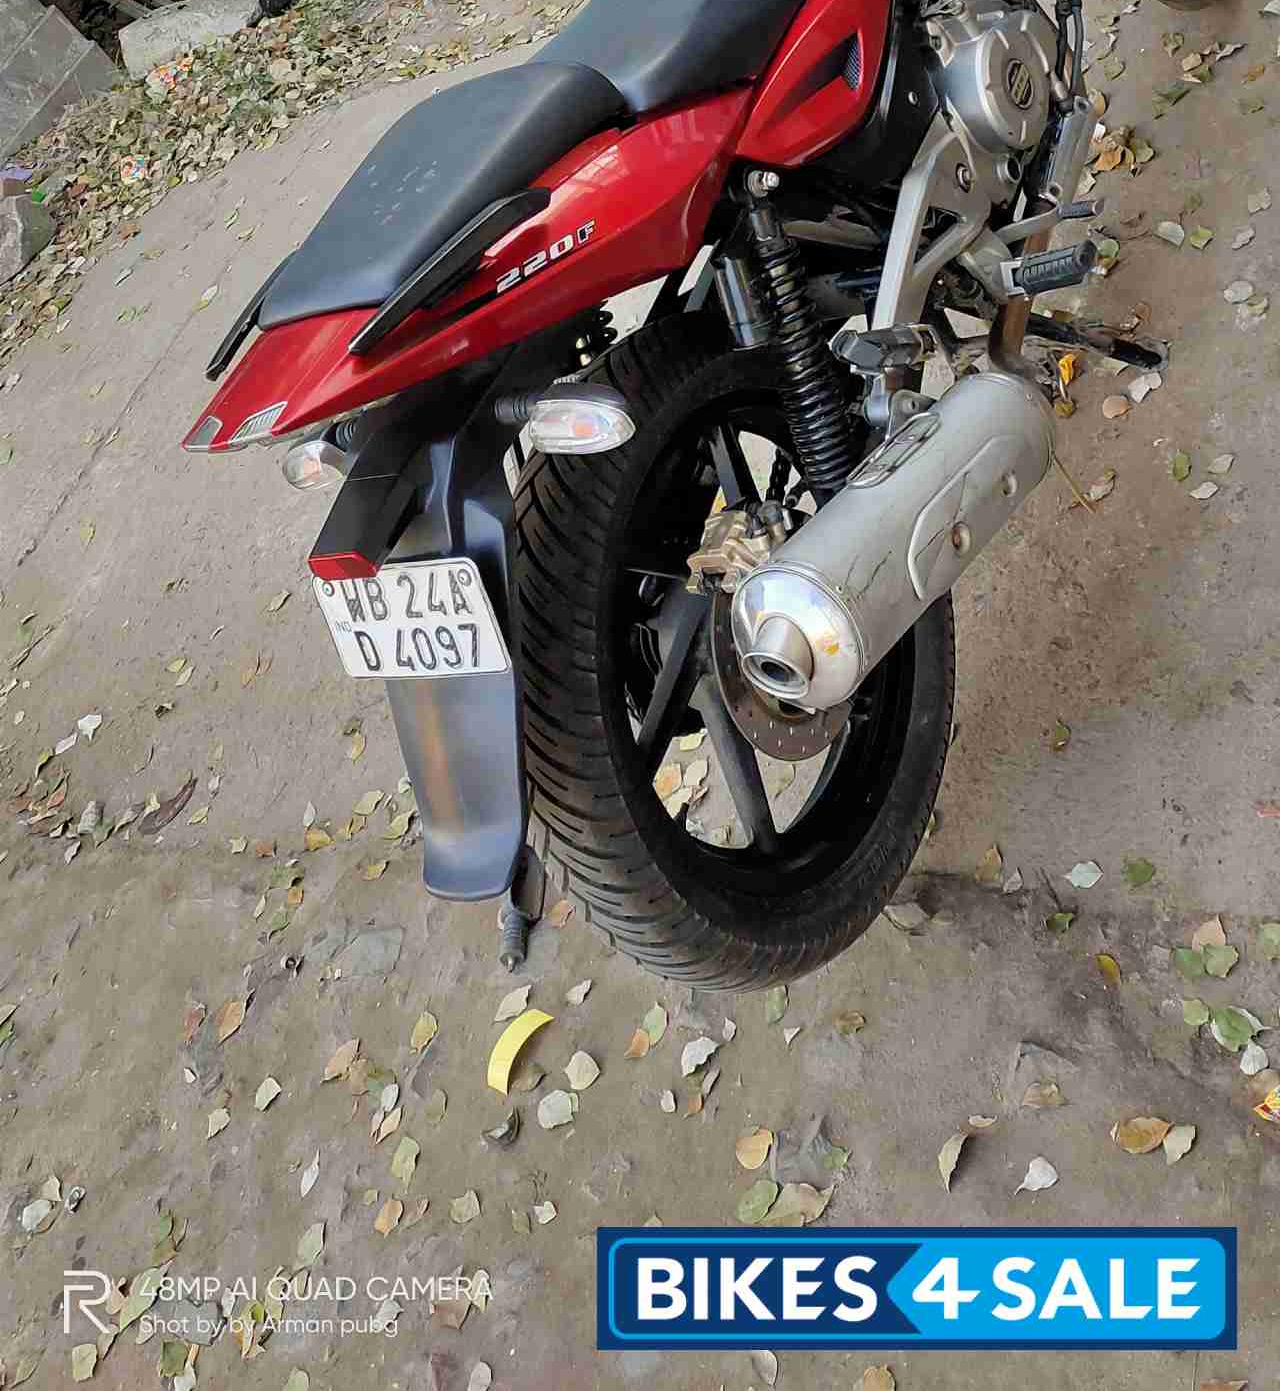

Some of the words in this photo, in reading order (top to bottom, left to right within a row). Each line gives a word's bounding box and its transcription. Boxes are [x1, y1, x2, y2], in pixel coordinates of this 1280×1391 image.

[496, 220, 596, 294] 220F
[341, 575, 388, 622] WB
[397, 570, 472, 618] 24A
[354, 631, 381, 671] D
[396, 623, 479, 671] 4097
